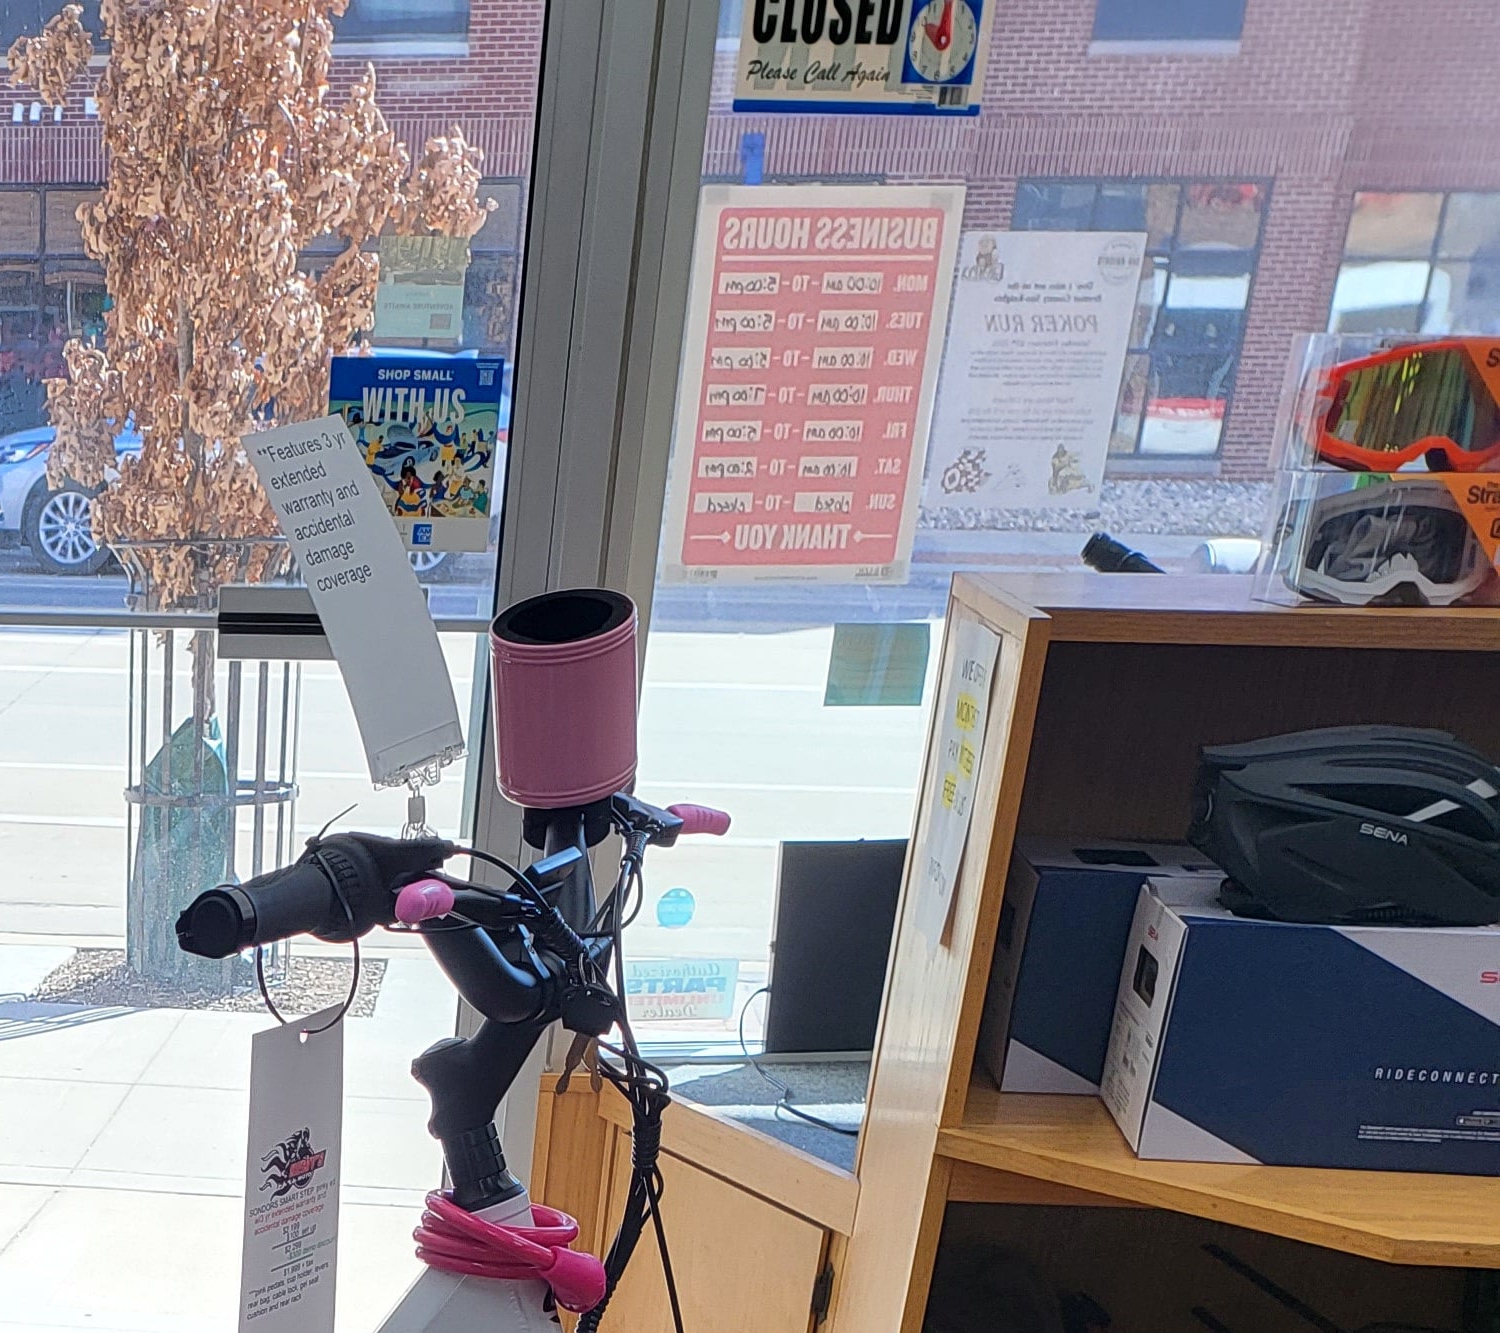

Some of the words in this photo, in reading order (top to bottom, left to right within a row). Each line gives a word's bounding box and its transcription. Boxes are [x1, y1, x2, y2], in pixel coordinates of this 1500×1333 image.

[753, 0, 903, 45] CLOSED
[746, 59, 797, 81] Please
[804, 61, 837, 84] Call
[842, 62, 890, 88] Again
[378, 369, 411, 381] SHOP
[414, 370, 453, 381] SMALL
[363, 387, 425, 423] WITH
[434, 388, 465, 423] US
[333, 431, 347, 451] yr
[271, 461, 327, 490] extended
[281, 490, 334, 515] warranty
[337, 481, 360, 501] and
[294, 509, 356, 541] accidental
[305, 540, 355, 566] damage
[317, 562, 372, 591] coverage
[1360, 823, 1408, 845] SENA
[249, 1201, 278, 1217] SONDORS
[280, 1194, 298, 1206] SMART
[300, 1187, 314, 1199] STEP
[254, 1222, 280, 1235] accidental
[280, 1213, 301, 1226] damage
[302, 1204, 324, 1217] coverage
[247, 1307, 268, 1320] cushion
